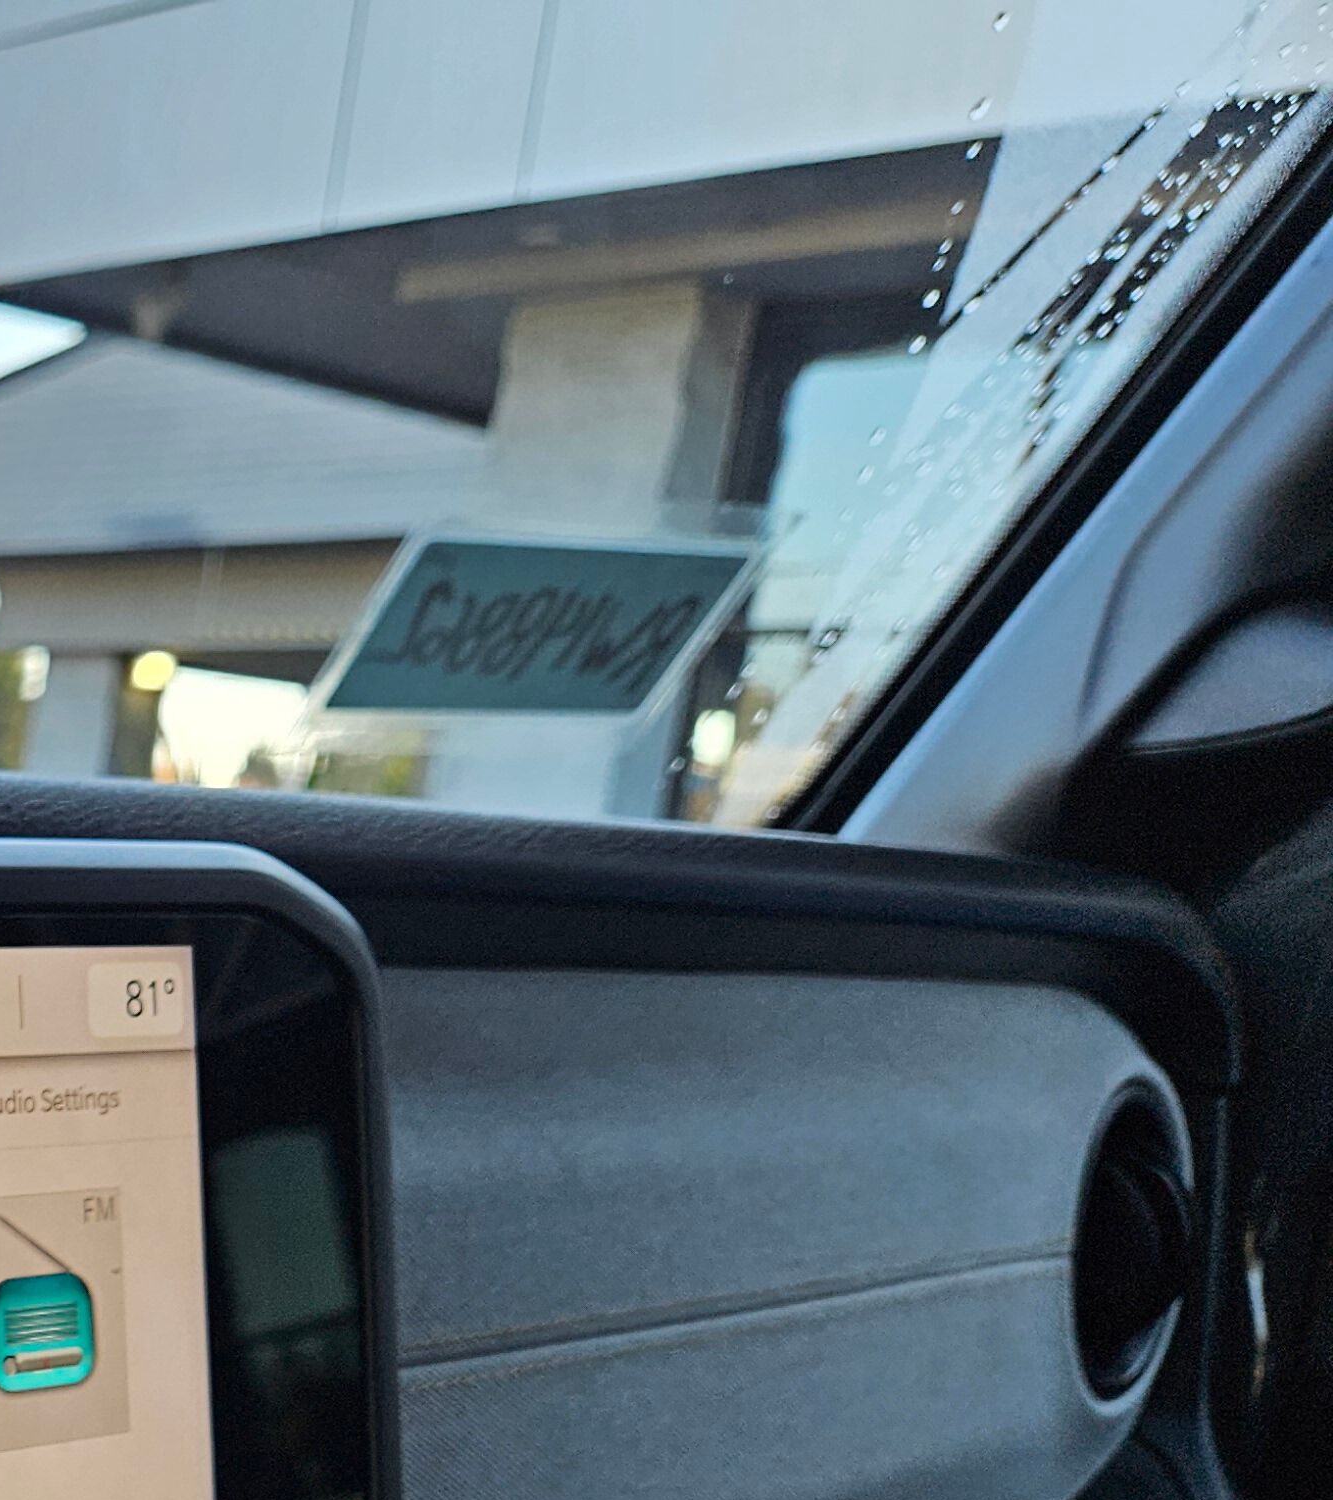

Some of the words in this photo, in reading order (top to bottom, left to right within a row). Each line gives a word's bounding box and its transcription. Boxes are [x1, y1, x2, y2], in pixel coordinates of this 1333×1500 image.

[126, 979, 176, 1017] 81°
[41, 1086, 119, 1115] Settings
[83, 1198, 116, 1223] FM
